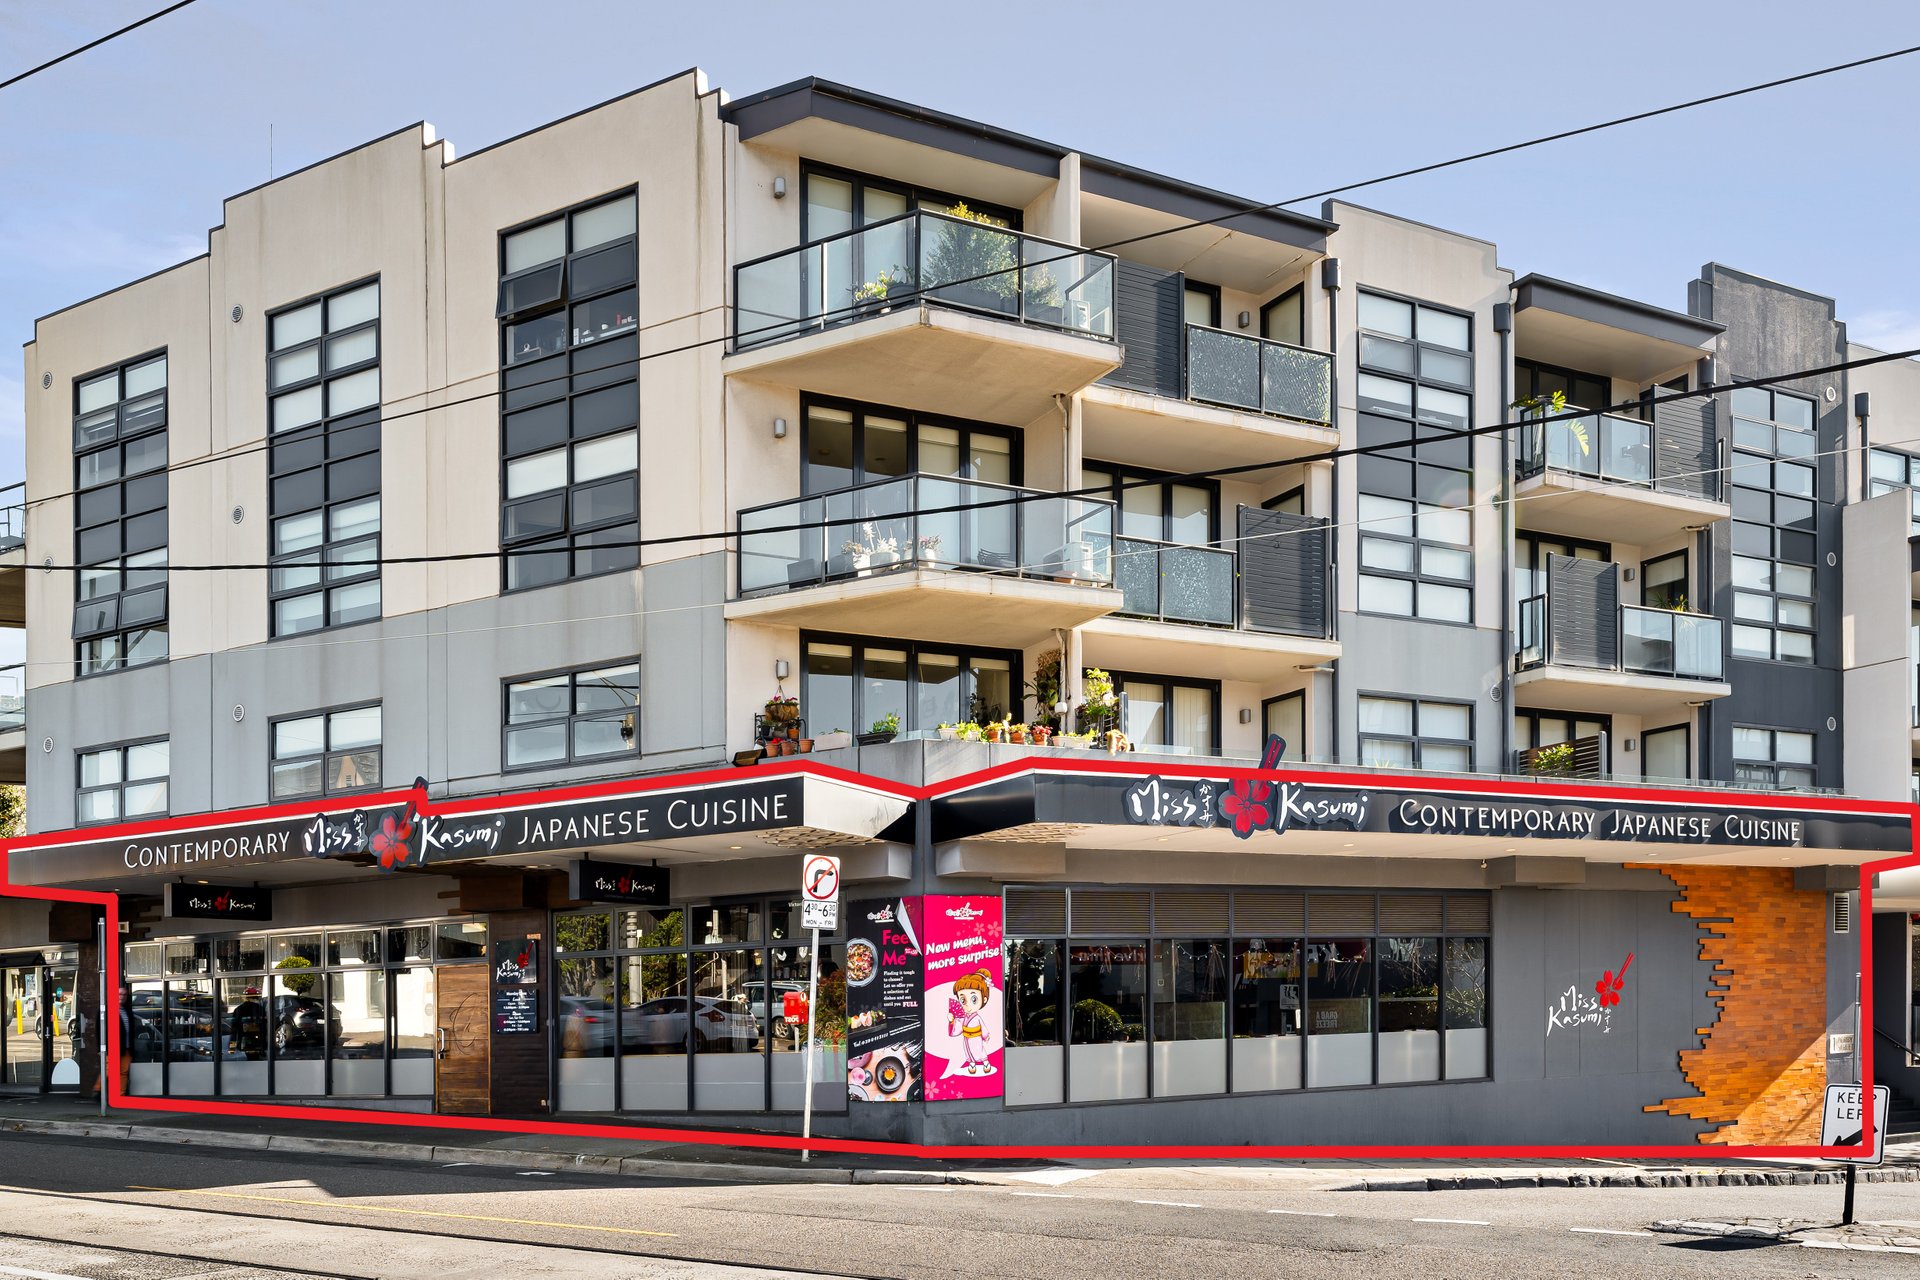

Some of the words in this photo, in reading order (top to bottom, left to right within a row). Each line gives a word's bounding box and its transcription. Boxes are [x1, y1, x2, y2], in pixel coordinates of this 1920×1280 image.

[518, 809, 649, 845] JAPANESE
[667, 794, 788, 829] CUISINE
[1131, 779, 1197, 821] Miss
[1279, 783, 1368, 830] Kasumi
[1400, 798, 1596, 833] CONTEMPORARY
[1610, 809, 1712, 838] JAPANESE
[1724, 814, 1801, 841] CUISINE
[124, 831, 290, 868] CONTEMPORARY
[304, 817, 353, 853] Miss
[419, 816, 502, 862] Kasumi
[882, 929, 909, 946] Fee
[925, 941, 951, 956] New
[953, 935, 987, 950] menu,
[881, 949, 907, 966] Me
[927, 956, 956, 971] more
[958, 943, 1003, 964] surprise!
[1560, 985, 1598, 1011] Miss
[1546, 1005, 1604, 1037] Kasumi
[1837, 1108, 1863, 1120] LEF
